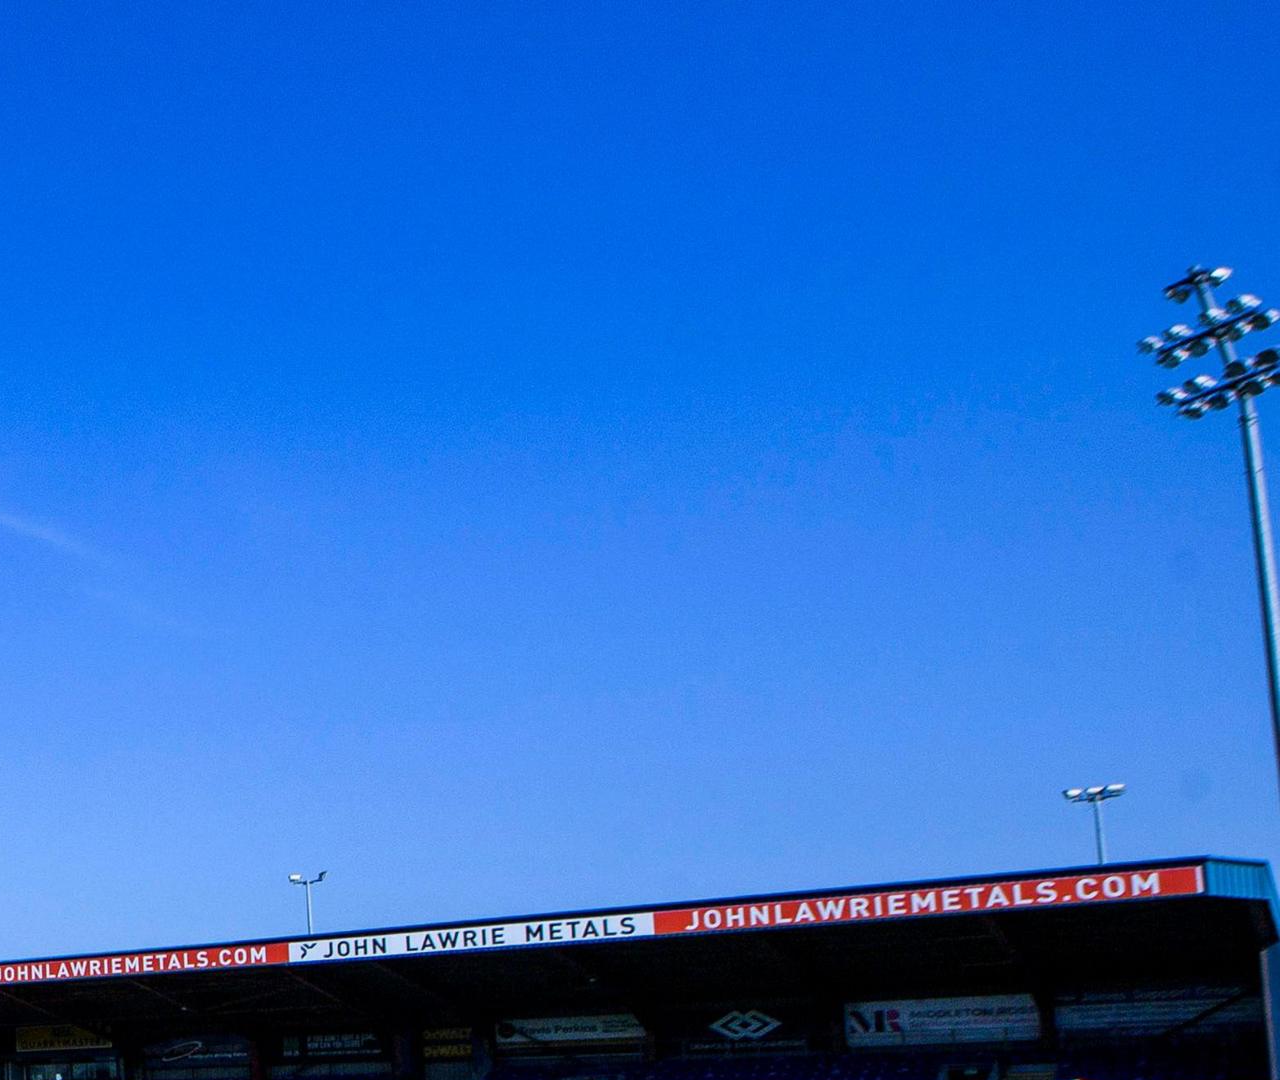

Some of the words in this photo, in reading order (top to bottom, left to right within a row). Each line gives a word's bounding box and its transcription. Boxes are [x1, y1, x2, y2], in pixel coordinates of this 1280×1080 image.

[685, 872, 1160, 931] JOHNLAWRIEMETALS.COM
[324, 938, 387, 958] JOHN
[406, 928, 505, 951] LAWRIE
[525, 917, 636, 942] METALS
